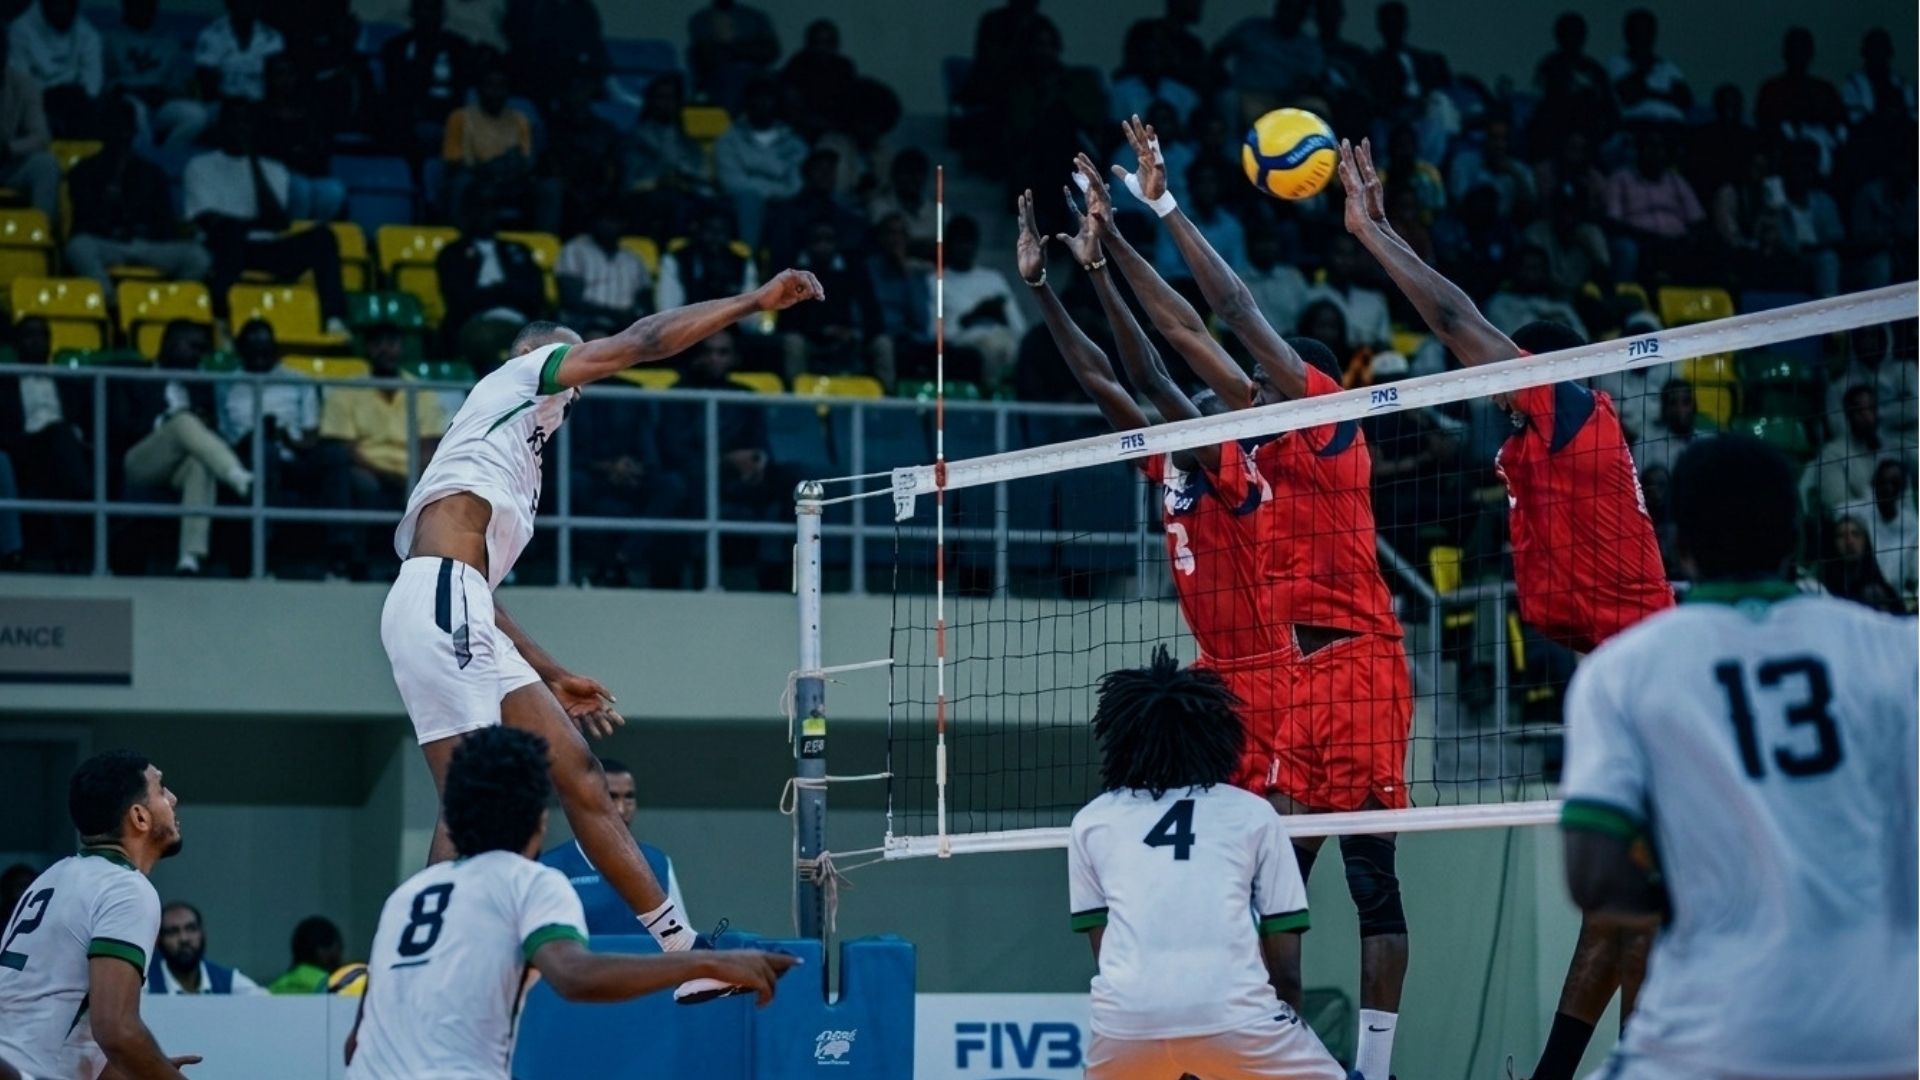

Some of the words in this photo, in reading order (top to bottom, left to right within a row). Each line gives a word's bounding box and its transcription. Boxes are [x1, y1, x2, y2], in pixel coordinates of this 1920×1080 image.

[0, 625, 65, 648] ANCE
[1713, 656, 1847, 780] 13
[1143, 798, 1196, 861] 4
[0, 887, 55, 971] 12
[397, 882, 455, 957] 8
[955, 1021, 1083, 1069] FIVB
